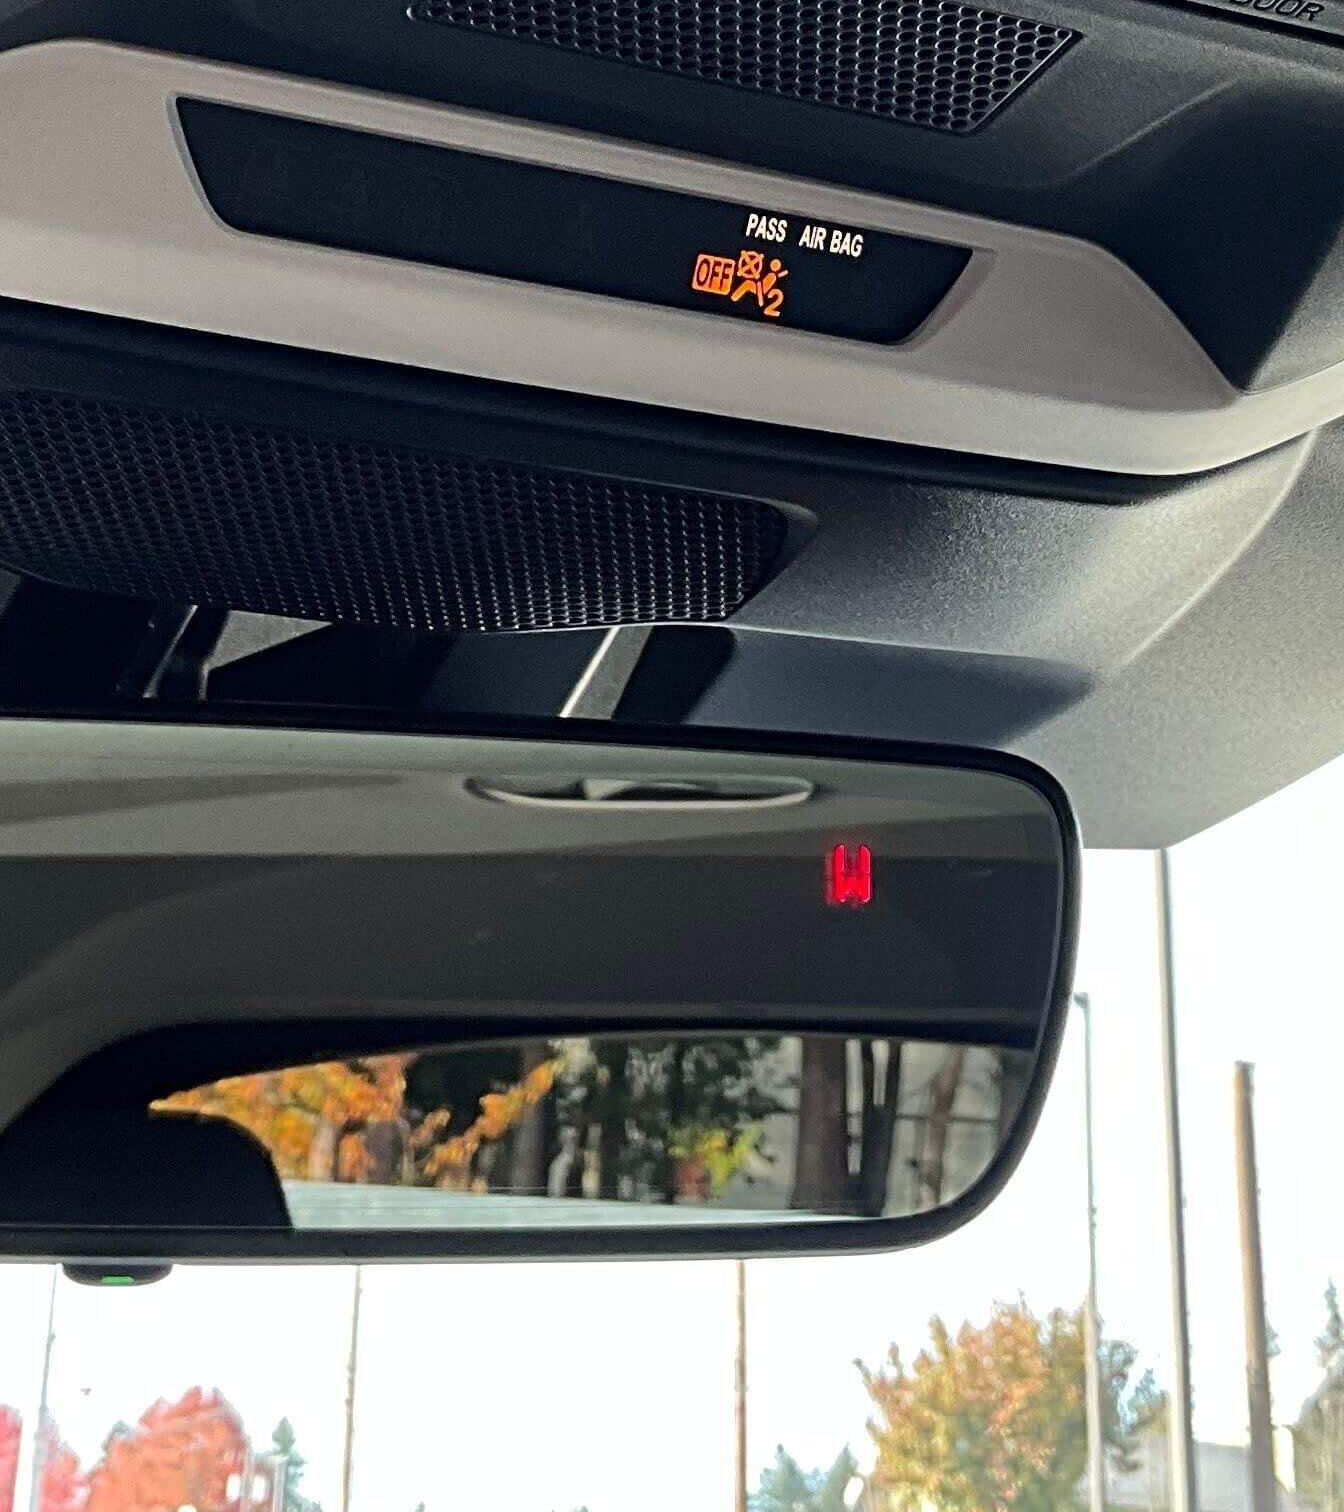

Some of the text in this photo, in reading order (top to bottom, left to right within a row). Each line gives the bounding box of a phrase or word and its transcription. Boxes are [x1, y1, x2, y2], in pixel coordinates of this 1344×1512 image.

[745, 213, 864, 258] PASS AIR BAG
[695, 257, 733, 292] OFF
[763, 289, 784, 317] 2
